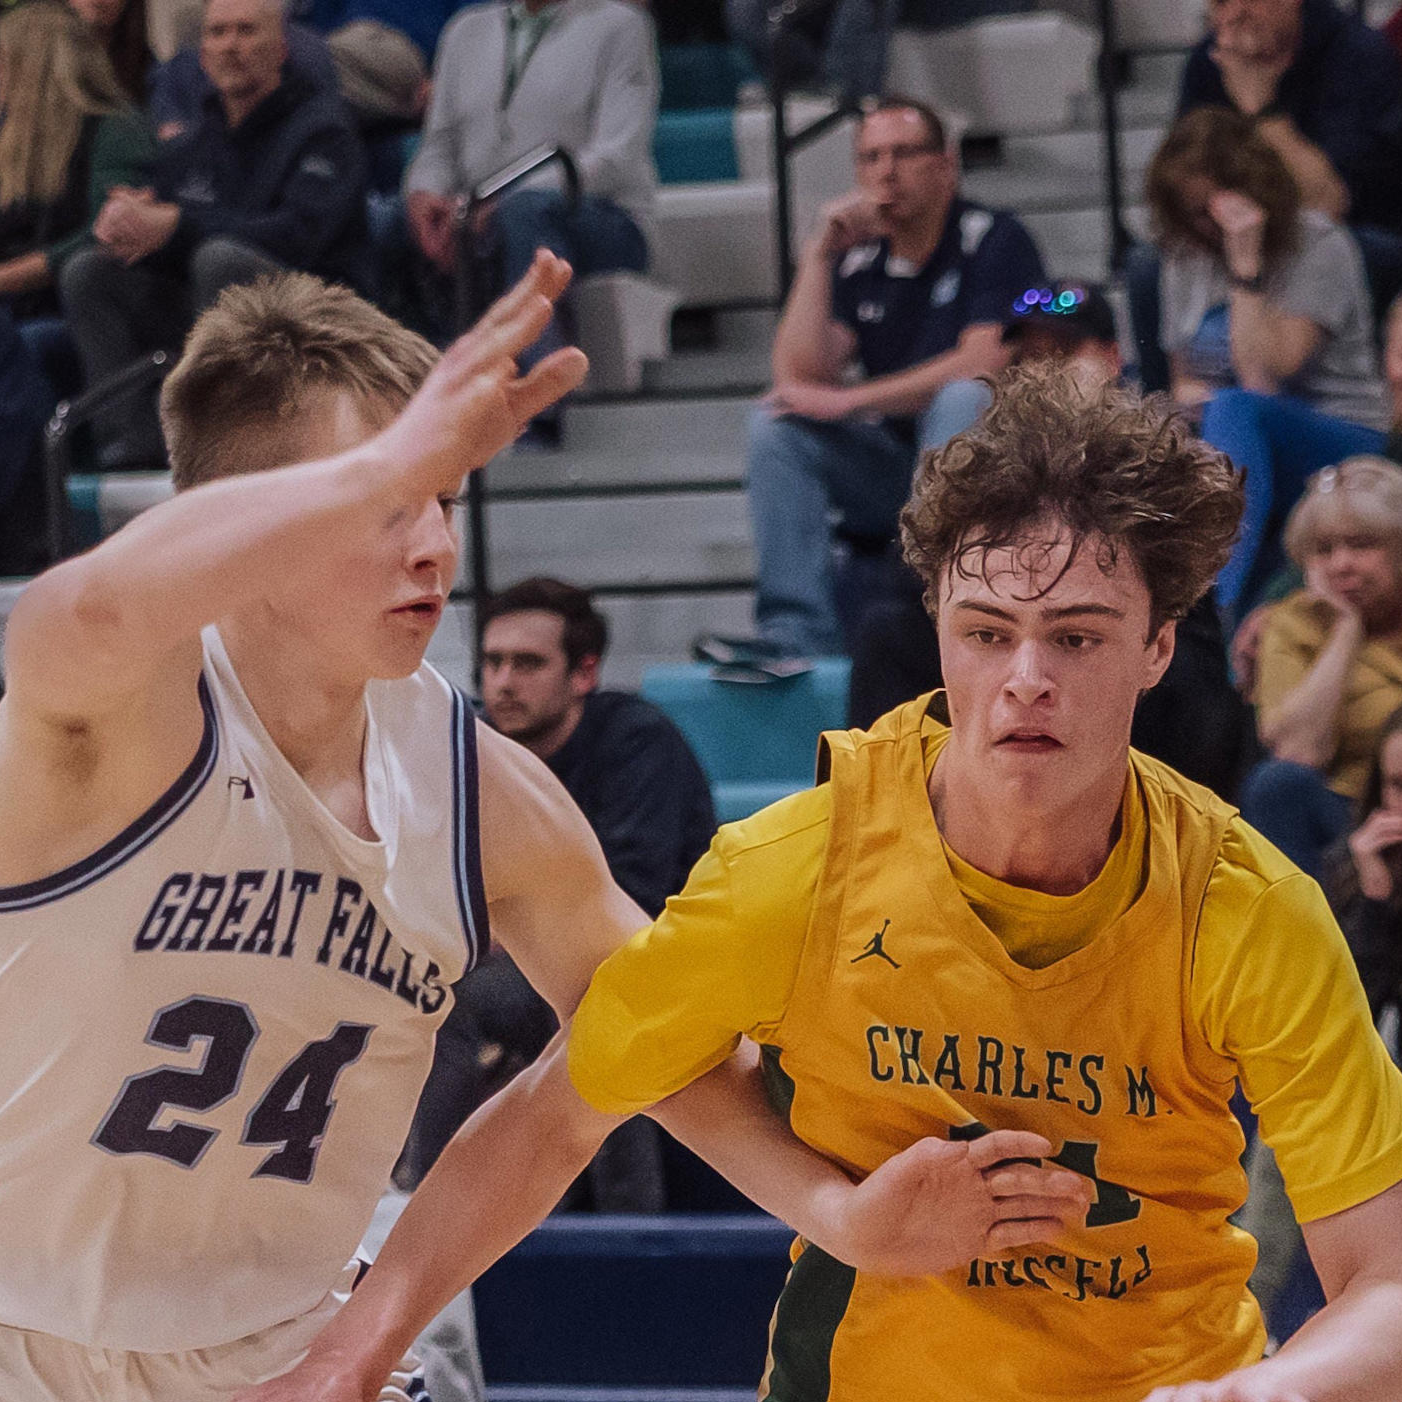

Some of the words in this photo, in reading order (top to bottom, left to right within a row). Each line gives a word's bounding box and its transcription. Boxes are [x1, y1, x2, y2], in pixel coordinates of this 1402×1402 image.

[133, 868, 322, 958] GREAT
[316, 876, 448, 1014] FALLS
[89, 993, 377, 1184] 24
[865, 1024, 1105, 1117] CHARLES
